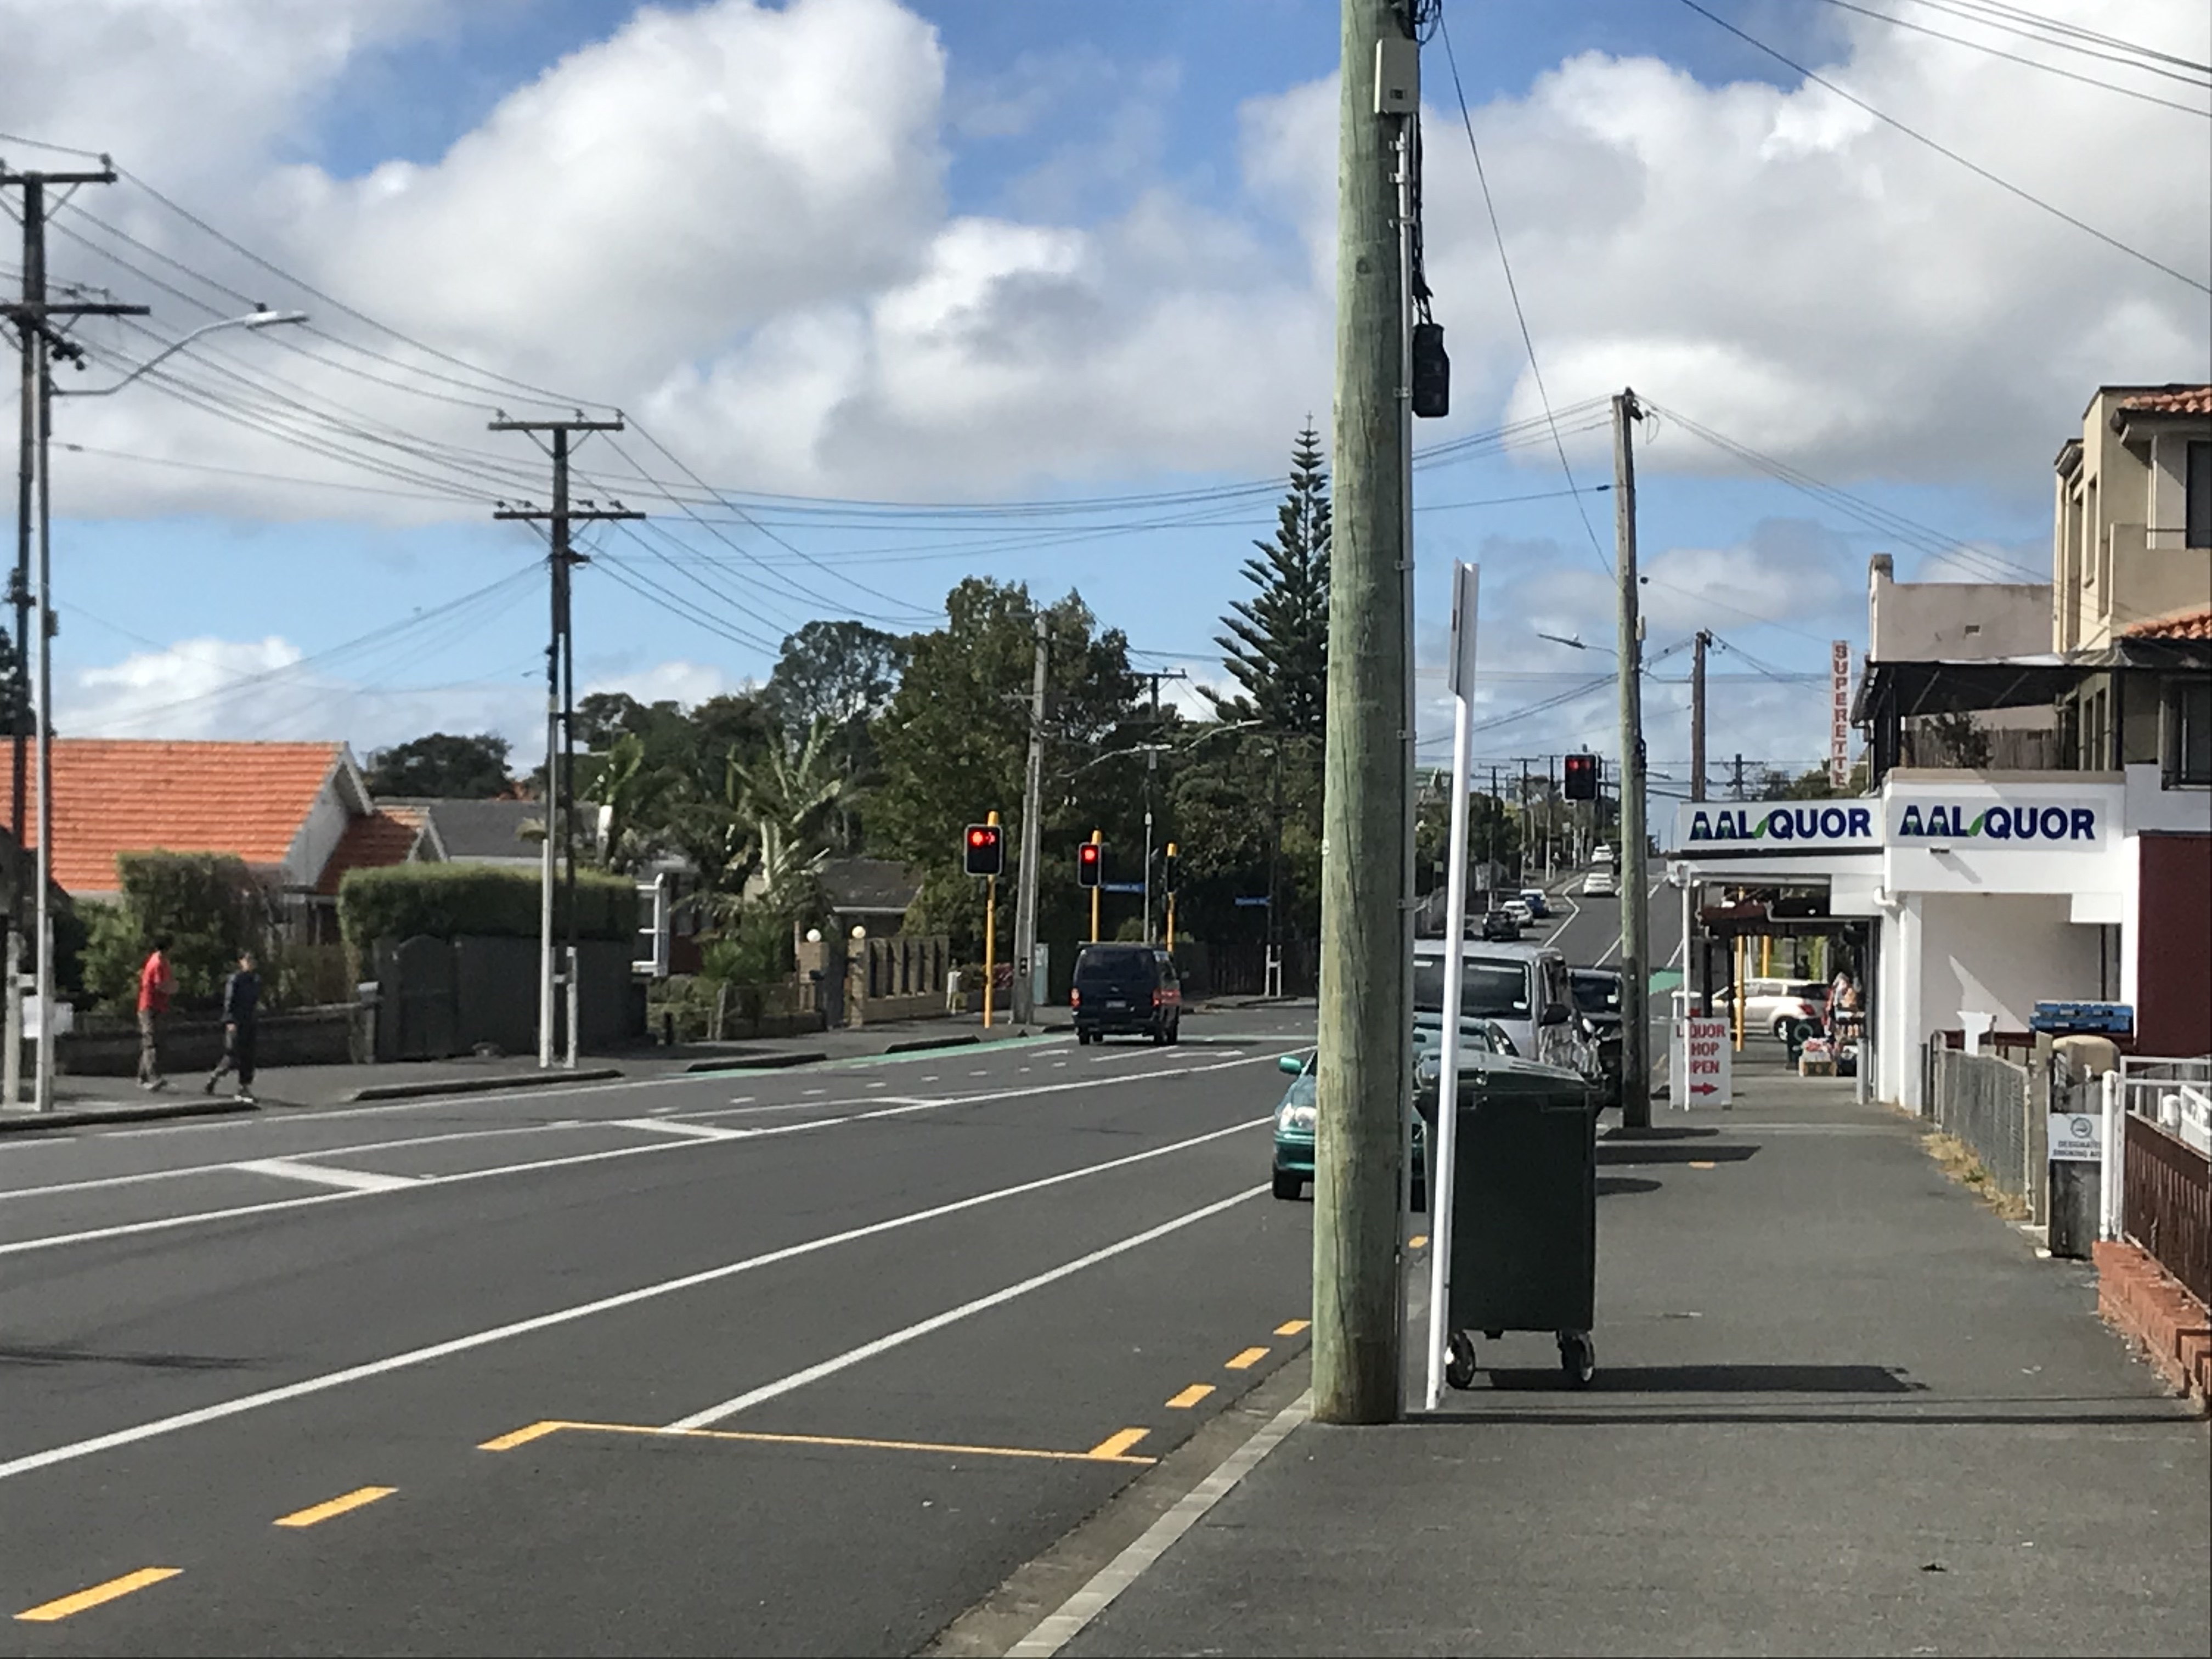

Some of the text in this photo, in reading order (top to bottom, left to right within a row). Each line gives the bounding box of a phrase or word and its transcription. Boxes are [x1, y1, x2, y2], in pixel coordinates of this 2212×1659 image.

[1834, 644, 1848, 786] SUPERETTE
[1676, 1023, 1726, 1038] LQUOR
[1684, 1042, 1719, 1056] HOP
[1684, 1060, 1719, 1074] PEN
